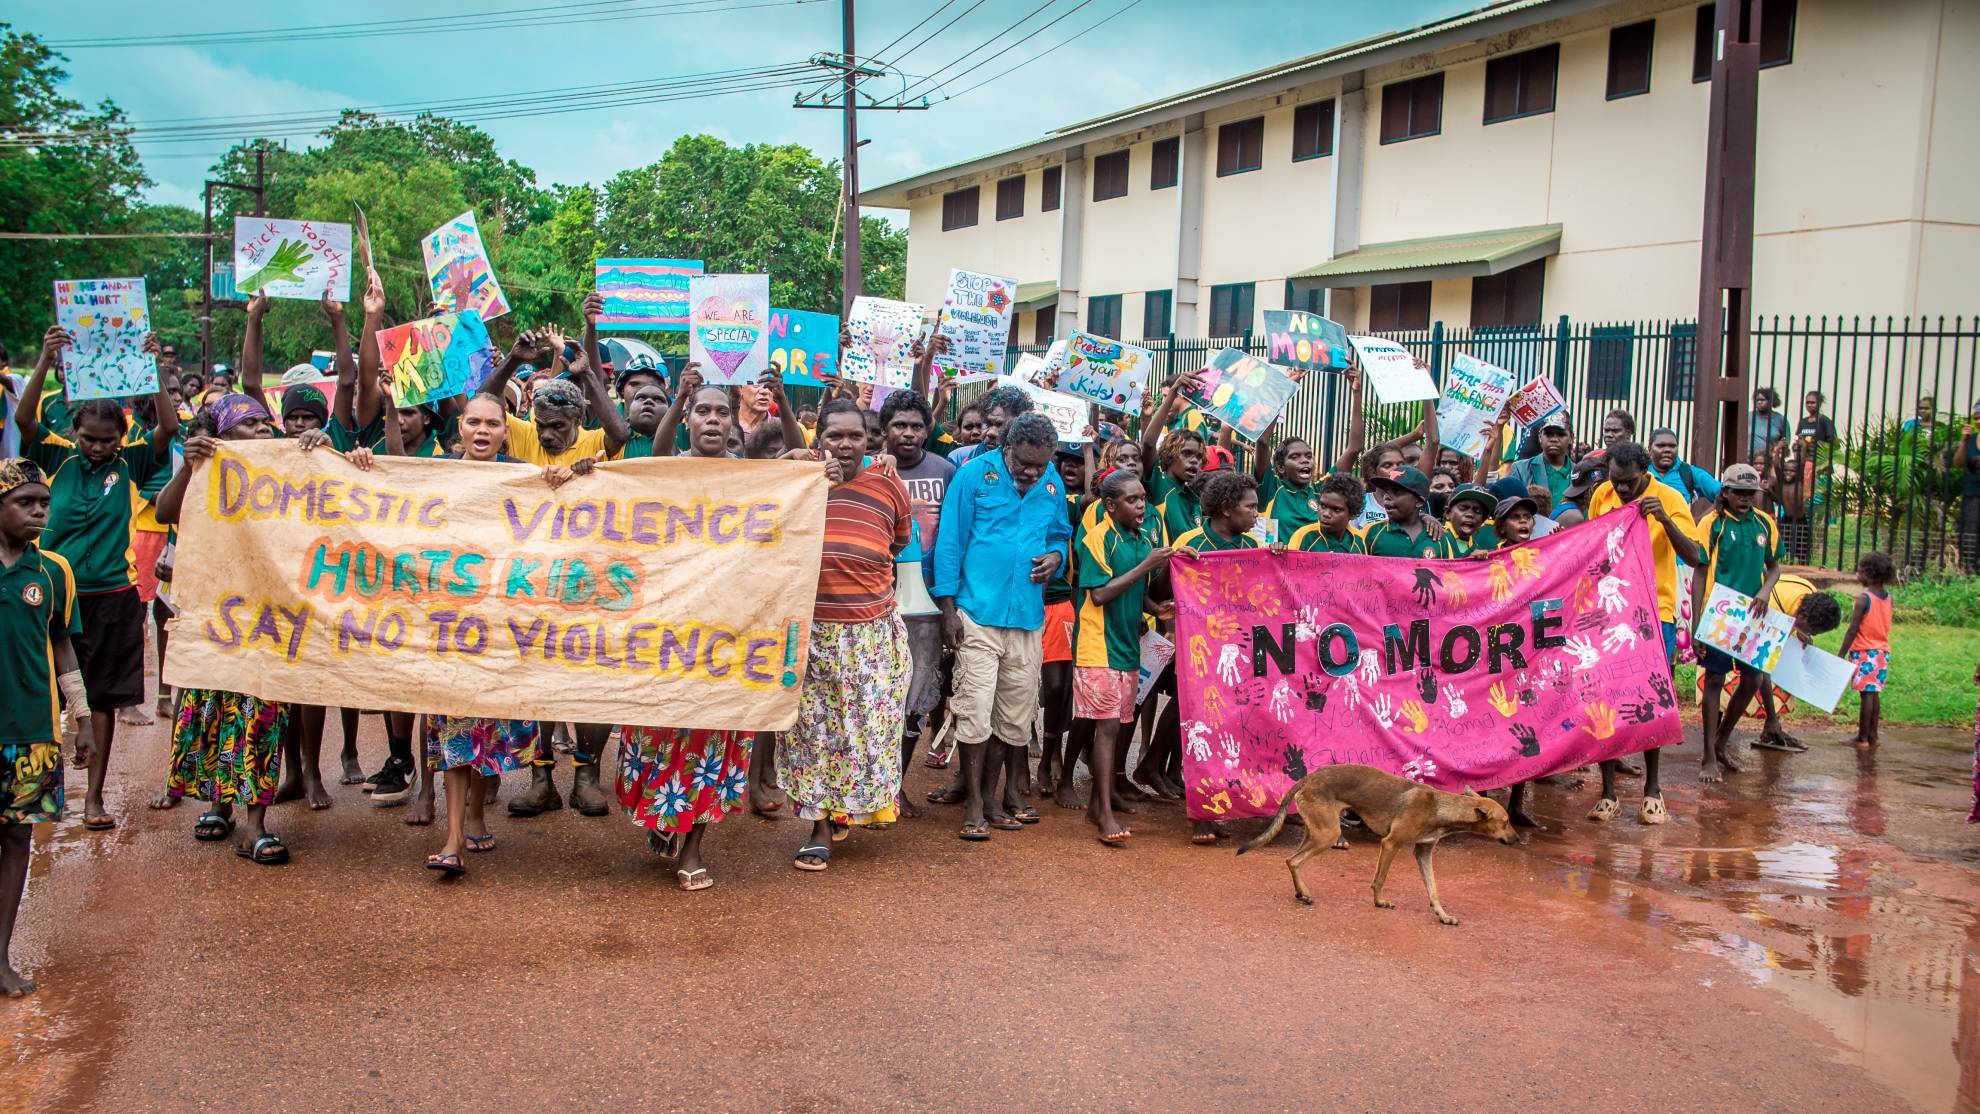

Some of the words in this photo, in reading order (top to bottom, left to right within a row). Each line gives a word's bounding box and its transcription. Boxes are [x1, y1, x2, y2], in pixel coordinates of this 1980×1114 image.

[241, 223, 280, 260] Stick
[79, 281, 97, 292] ME
[956, 271, 992, 292] STOP
[704, 310, 720, 321] WE
[734, 309, 755, 321] ARE
[769, 313, 807, 341] NO
[1289, 312, 1323, 337] NO
[411, 322, 453, 356] NO
[707, 329, 754, 341] SPECIAL
[1073, 336, 1113, 356] Protect
[1271, 332, 1349, 369] MORE
[770, 347, 831, 381] ORE
[1089, 363, 1117, 377] your
[1226, 358, 1267, 388] NO
[1185, 368, 1272, 432] MORE
[218, 457, 447, 529] DOMESTIC
[503, 499, 779, 544] VIOLENCE
[306, 542, 487, 598] HURTS
[506, 556, 638, 611] KIDS
[206, 596, 311, 662] SAY
[337, 609, 407, 654] NO
[429, 610, 488, 656] TO
[1252, 619, 1361, 678] NO
[1383, 597, 1567, 676] MORE
